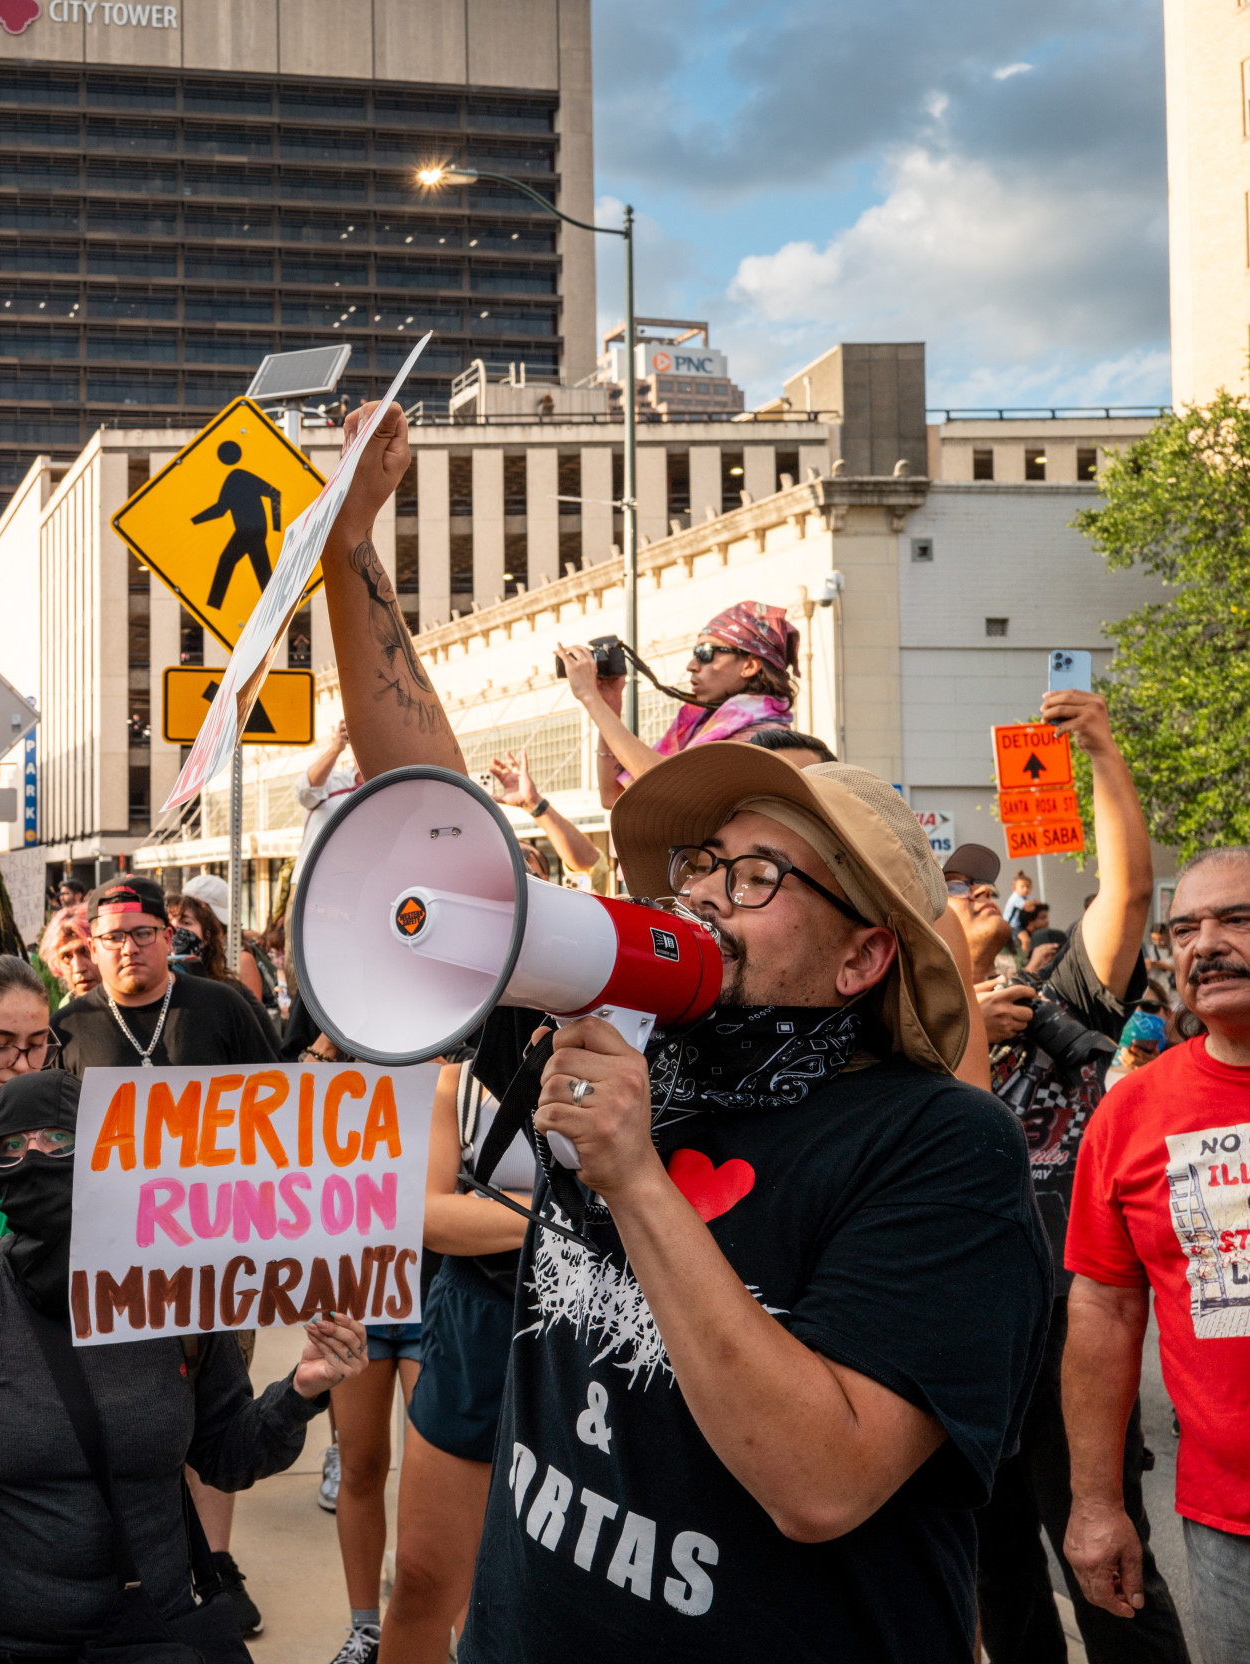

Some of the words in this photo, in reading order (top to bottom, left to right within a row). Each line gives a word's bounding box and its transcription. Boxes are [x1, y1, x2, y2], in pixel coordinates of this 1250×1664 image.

[49, 0, 97, 23] CITY
[100, 2, 177, 28] TOWER
[674, 355, 714, 374] PNC
[1002, 731, 1061, 749] DETOUR
[25, 740, 36, 819] PARK
[1003, 799, 1029, 815] SANTA
[1036, 798, 1057, 813] ROSA
[1064, 796, 1073, 811] ST
[1011, 831, 1037, 850] SAN
[1042, 827, 1079, 847] SABA
[90, 1070, 403, 1172] AMERICA
[1200, 1134, 1241, 1156] NO
[135, 1172, 312, 1248] RUNS
[320, 1172, 398, 1237] ON
[70, 1245, 418, 1339] IMMIGRANTS
[576, 1381, 612, 1454] &
